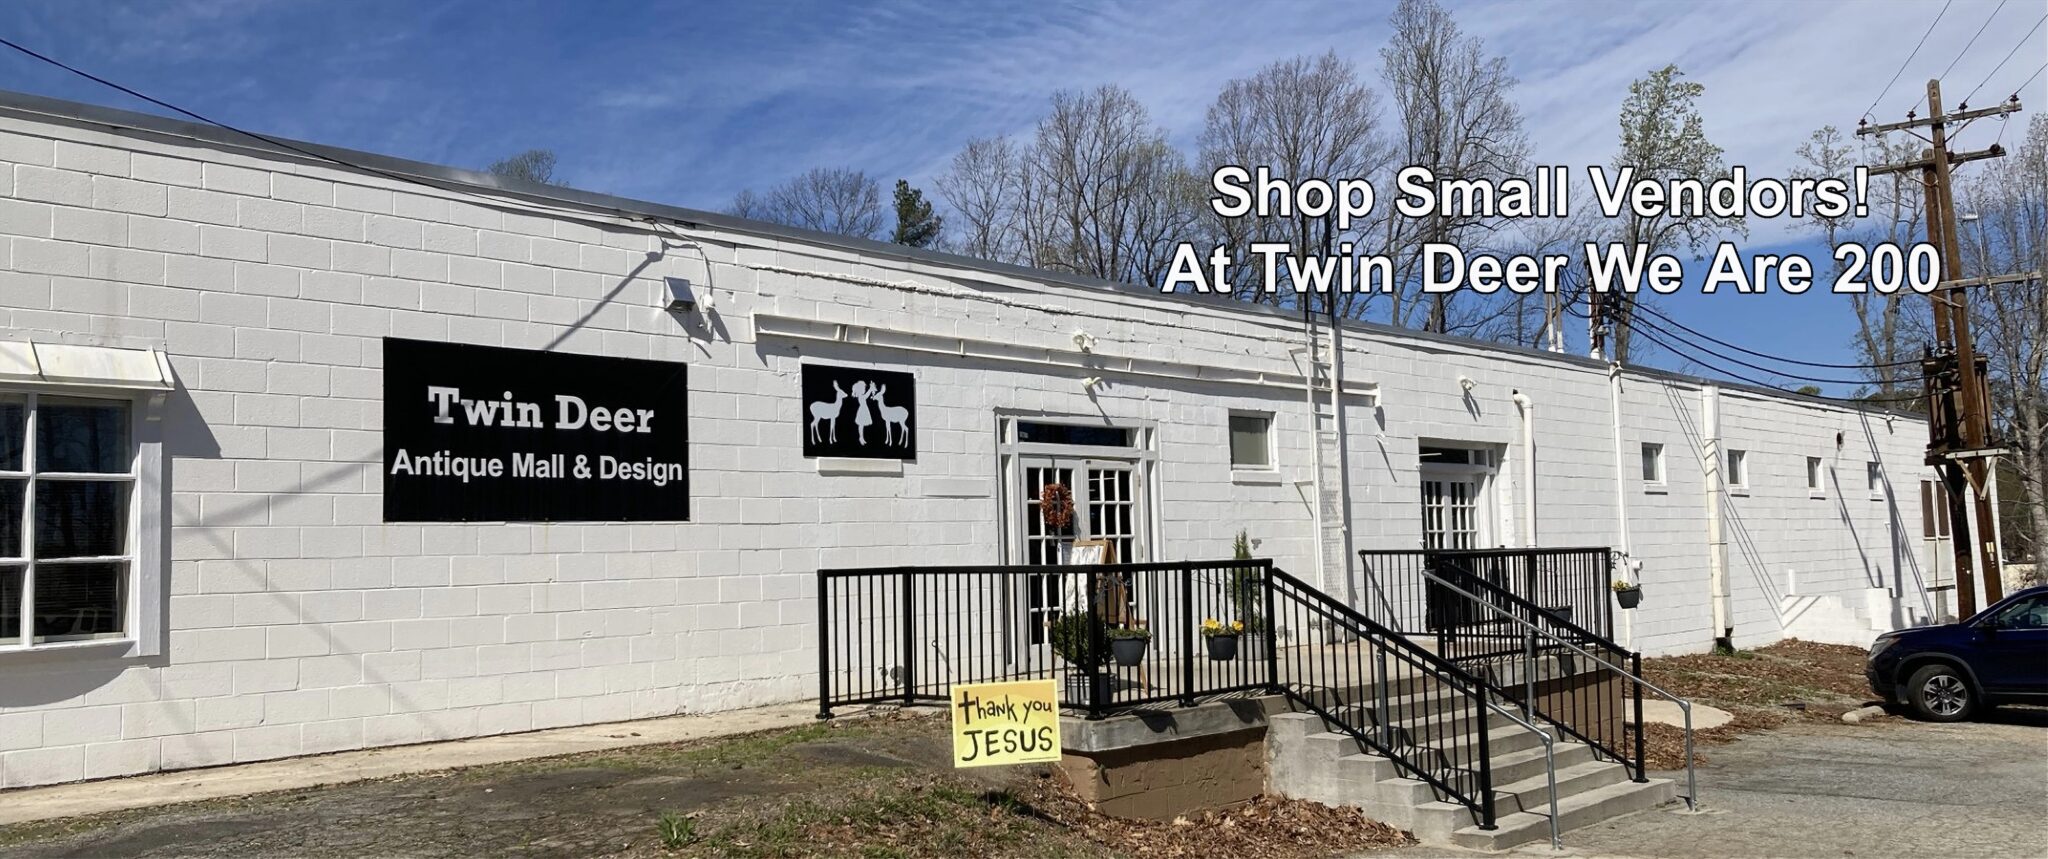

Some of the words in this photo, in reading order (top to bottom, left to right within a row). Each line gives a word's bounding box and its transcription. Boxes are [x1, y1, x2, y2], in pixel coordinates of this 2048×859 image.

[428, 385, 544, 429] Twin
[555, 394, 655, 434] Deer
[391, 448, 504, 484] Antique
[513, 452, 565, 479] Mall
[573, 454, 593, 479] &
[600, 455, 683, 487] Design
[1023, 700, 1052, 724] you
[961, 726, 1053, 761] JESUS
